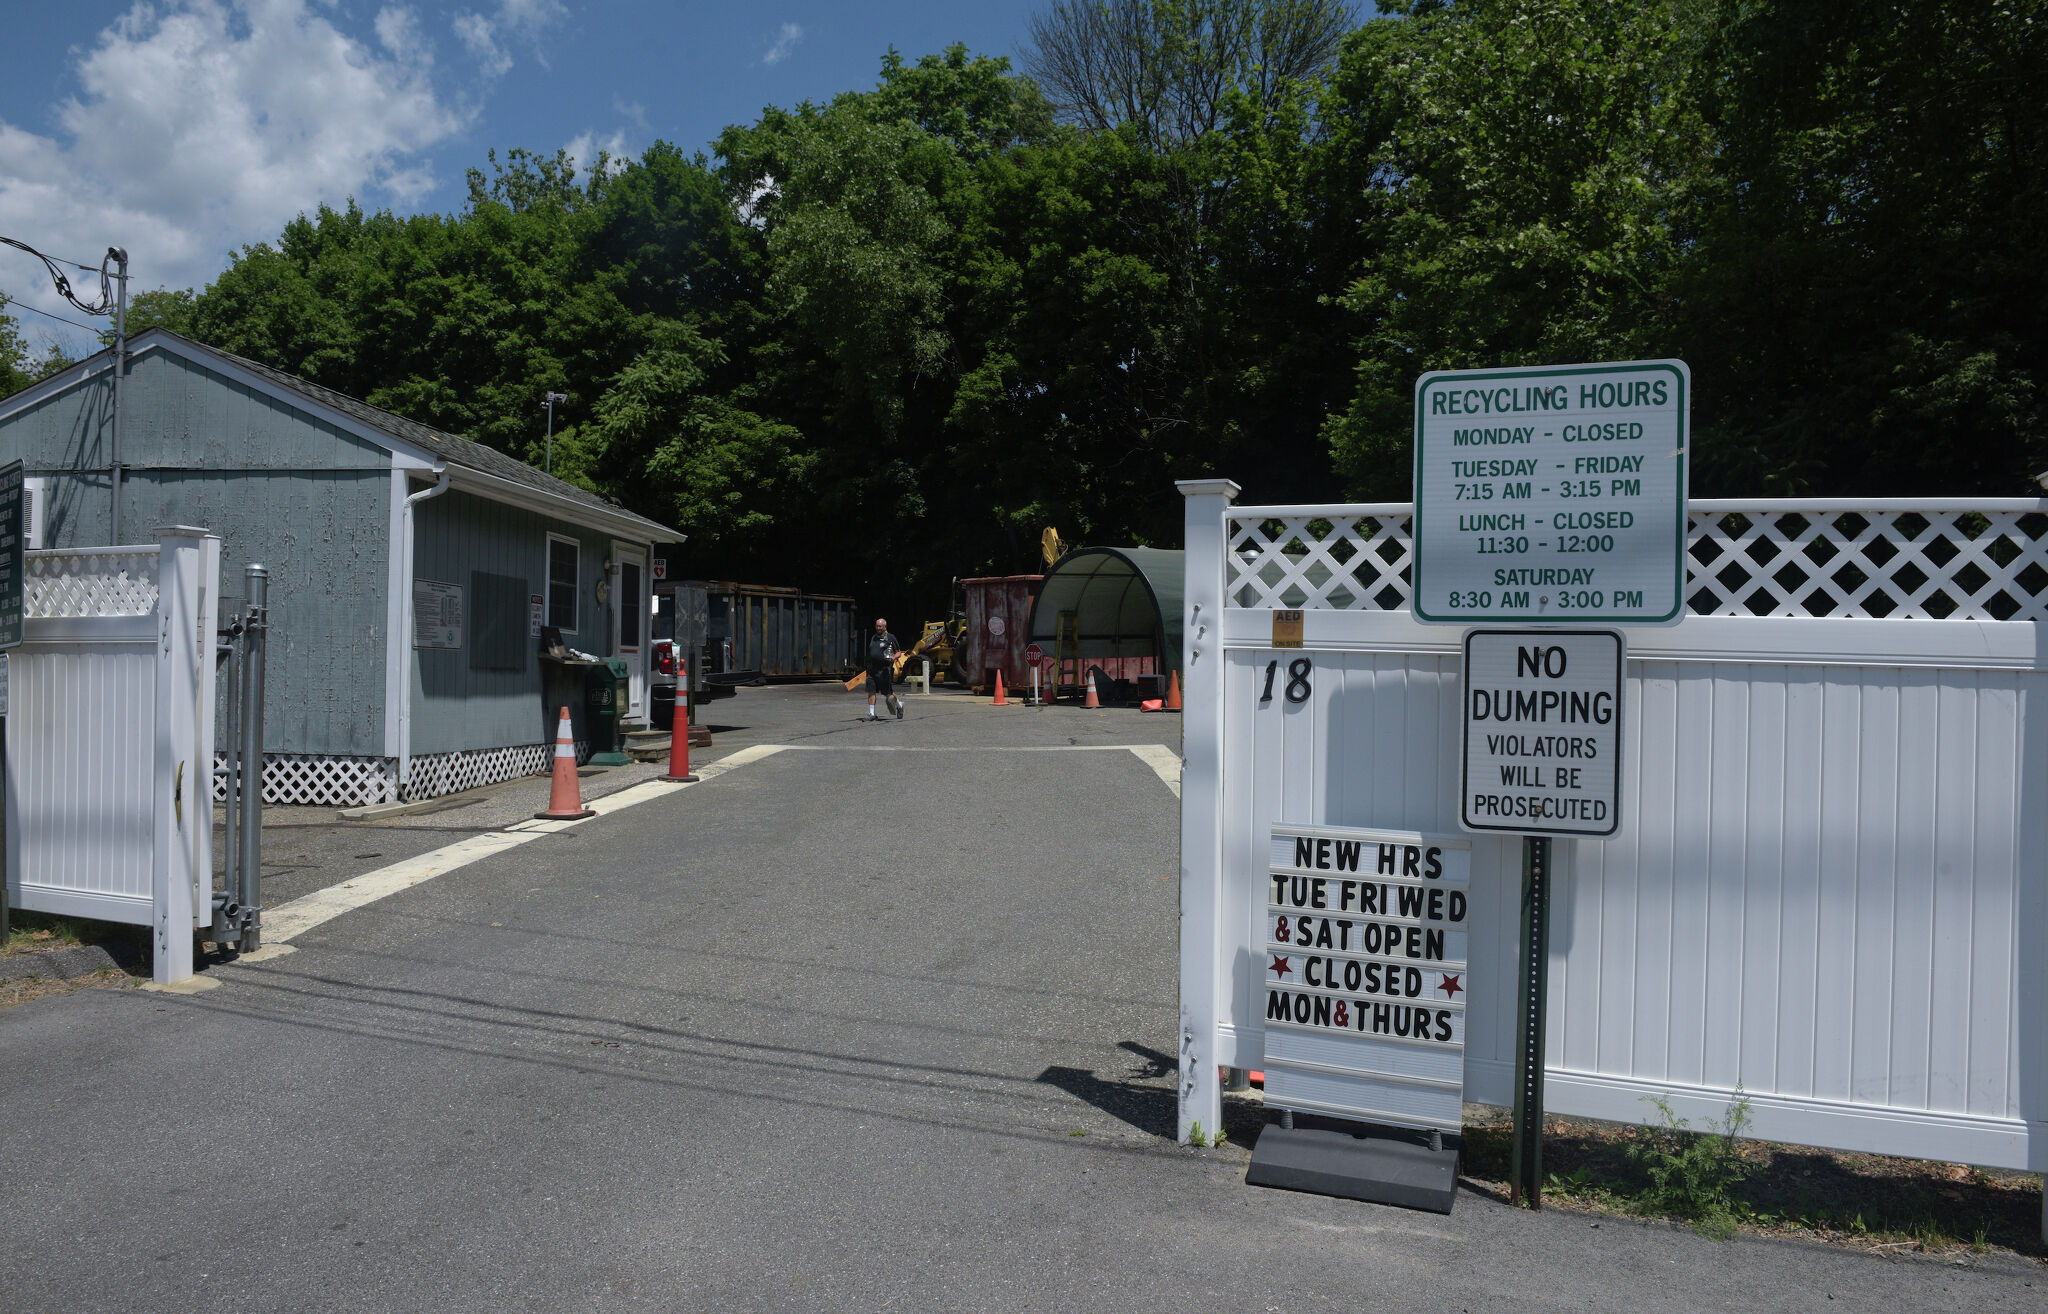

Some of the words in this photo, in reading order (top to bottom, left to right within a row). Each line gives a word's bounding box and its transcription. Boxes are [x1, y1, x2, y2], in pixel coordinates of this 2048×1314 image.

[1432, 385, 1568, 415] RECYCLING
[1580, 380, 1668, 409] HOURS
[1453, 427, 1535, 446] MONDAY
[1562, 422, 1643, 442] CLOSED
[1451, 459, 1538, 478] TUESDAY
[1574, 455, 1645, 474] FRIDAY
[1454, 483, 1494, 500] 7:15
[1502, 482, 1532, 499] AM
[1559, 480, 1601, 498] 3:15
[1611, 479, 1641, 497] PM
[1459, 513, 1526, 532] LUNCH
[1553, 511, 1634, 531] CLOSED
[1477, 536, 1529, 554] 11:30
[1556, 535, 1614, 553] 12:00
[1494, 568, 1595, 586] SATURDAY
[1449, 591, 1492, 608] 8:30
[1500, 591, 1530, 608] AM
[1557, 591, 1604, 608] 3:00
[1613, 591, 1643, 608] PM
[1276, 611, 1301, 622] AED
[1027, 651, 1040, 660] STOP
[1517, 646, 1567, 679] NO
[1260, 657, 1312, 704] 18
[1472, 689, 1612, 725] DUMPING
[1487, 734, 1597, 759] VIOLATORS
[1500, 765, 1546, 788] WILL
[1555, 767, 1582, 789] BE
[1474, 794, 1607, 821] PROSECUTED
[1295, 836, 1361, 872] NEW
[1378, 842, 1442, 879] HRS
[1273, 874, 1326, 909] TUE
[1340, 880, 1388, 915] FRI
[1398, 886, 1467, 922] WED
[1364, 922, 1444, 961] OPEN
[1305, 955, 1422, 998] CLOSED
